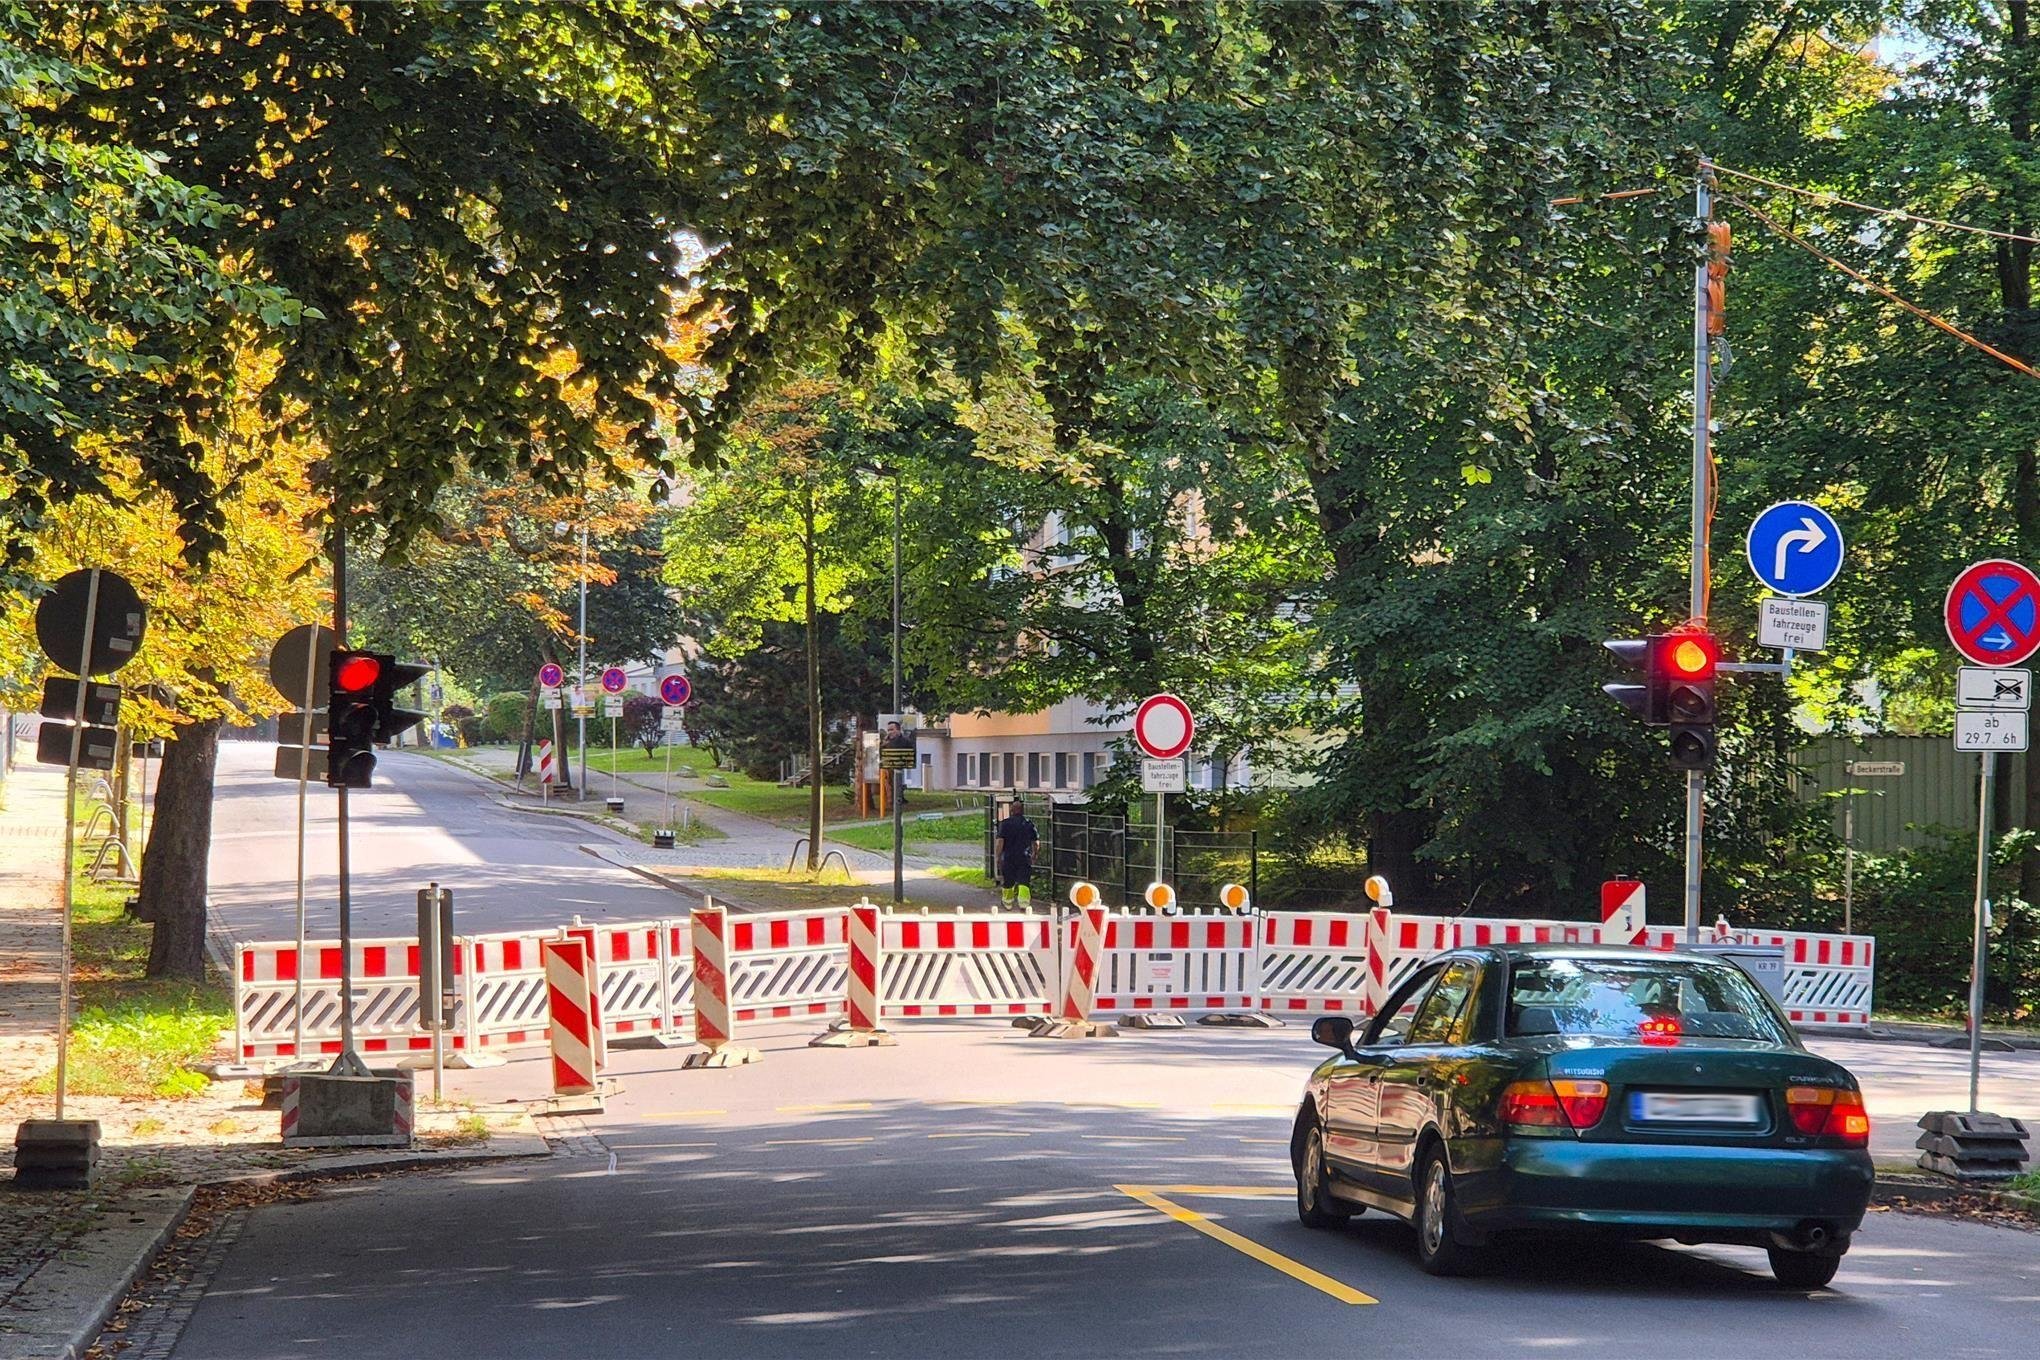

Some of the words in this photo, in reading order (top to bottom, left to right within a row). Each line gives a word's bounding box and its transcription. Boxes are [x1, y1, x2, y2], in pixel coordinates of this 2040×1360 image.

[1769, 604, 1821, 618] Baustellen-
[1773, 618, 1817, 633] fahrzeuge
[1784, 632, 1804, 643] frei
[1984, 717, 1999, 728] ab
[1965, 732, 1996, 744] 29.7.
[2003, 732, 2017, 744] 6h
